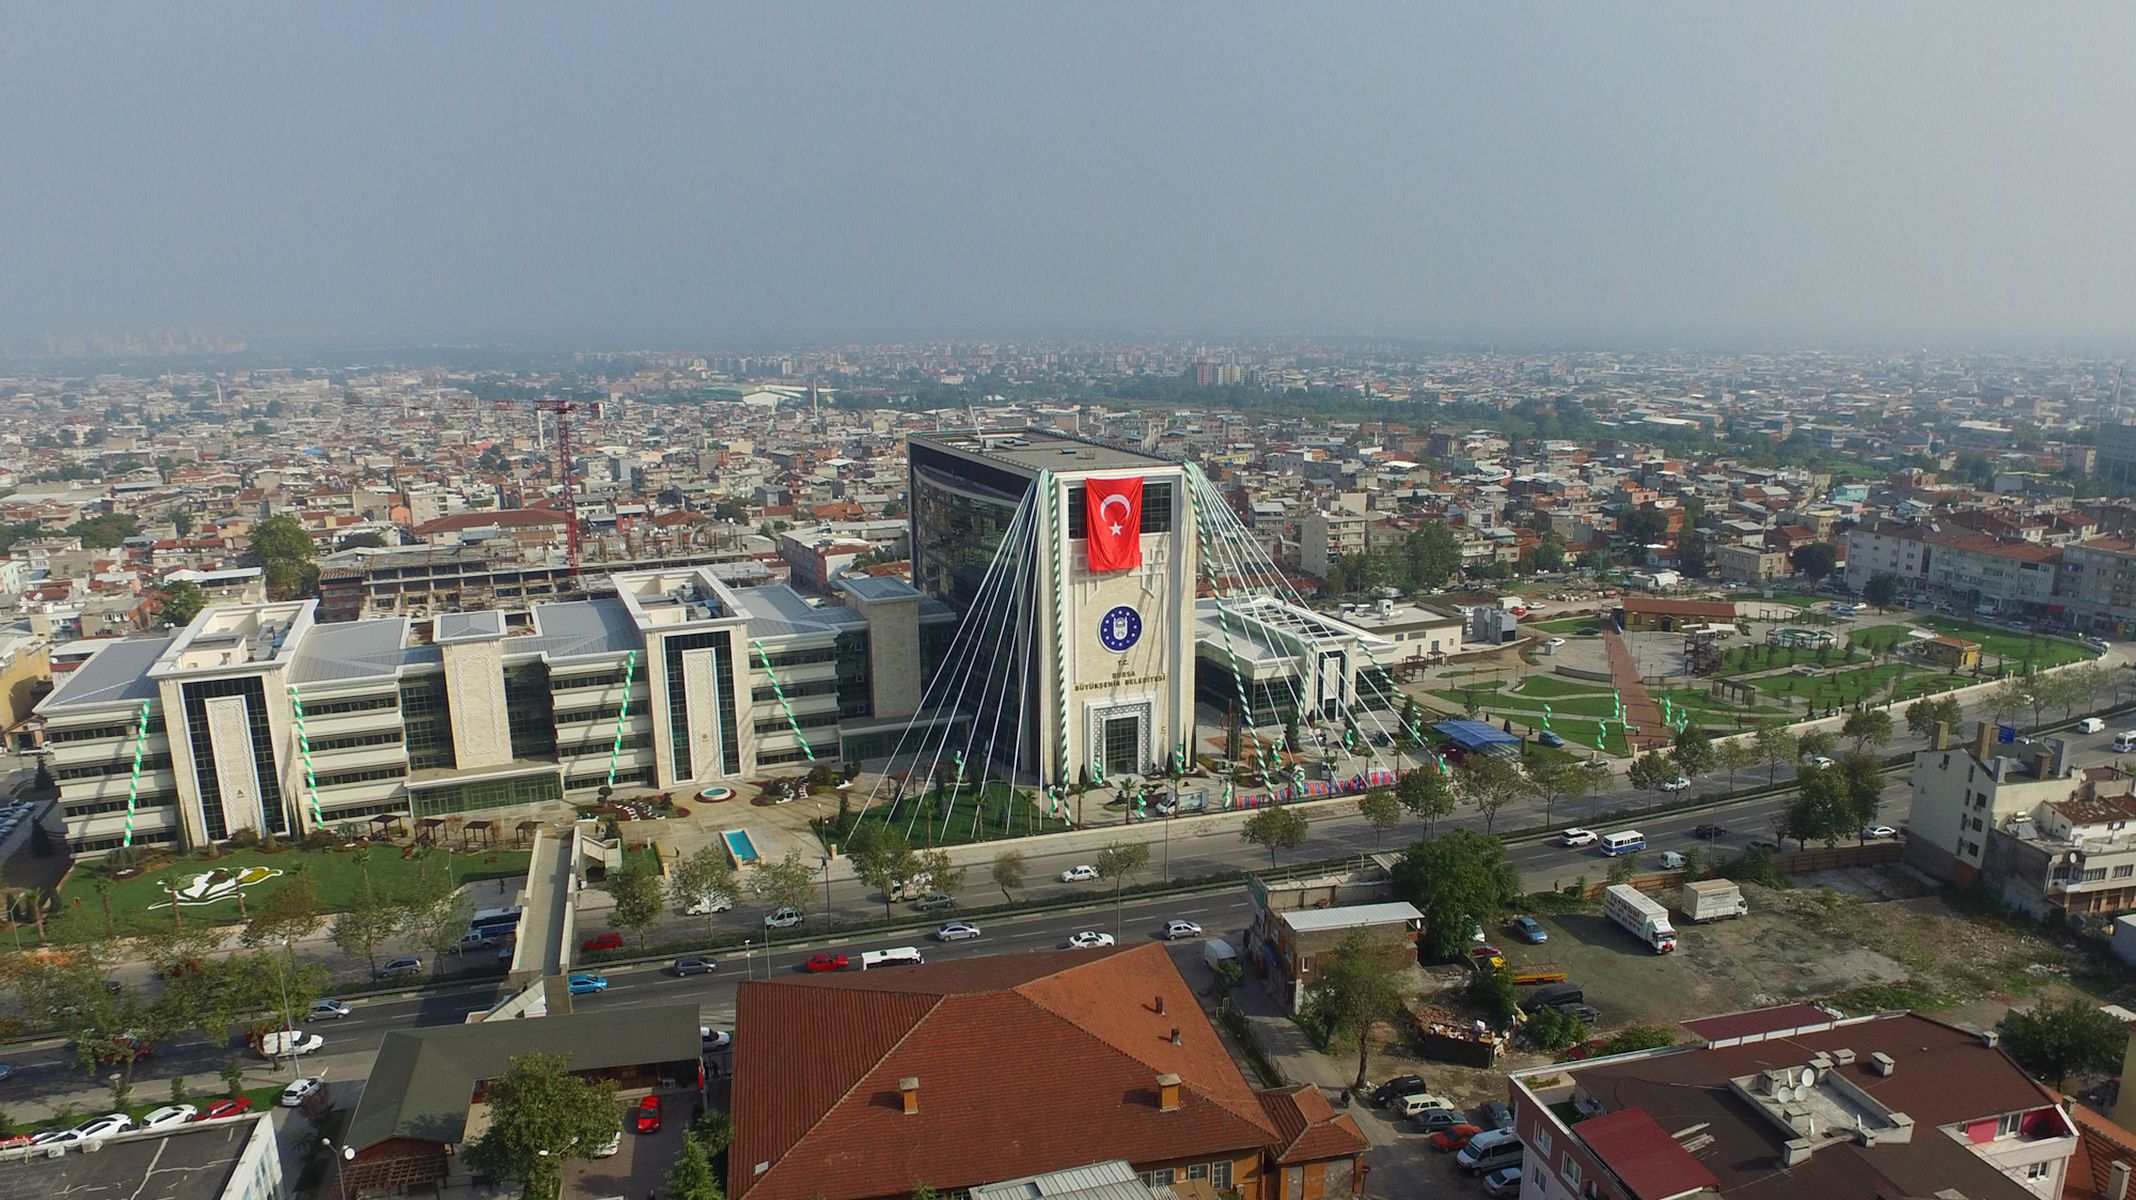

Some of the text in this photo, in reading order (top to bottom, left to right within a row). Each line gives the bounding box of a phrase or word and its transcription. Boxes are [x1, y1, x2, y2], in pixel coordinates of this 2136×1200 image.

[1112, 671, 1136, 679] BURSA
[1075, 673, 1166, 692] BÜYÜKŞEHİR BELEDİYESİ
